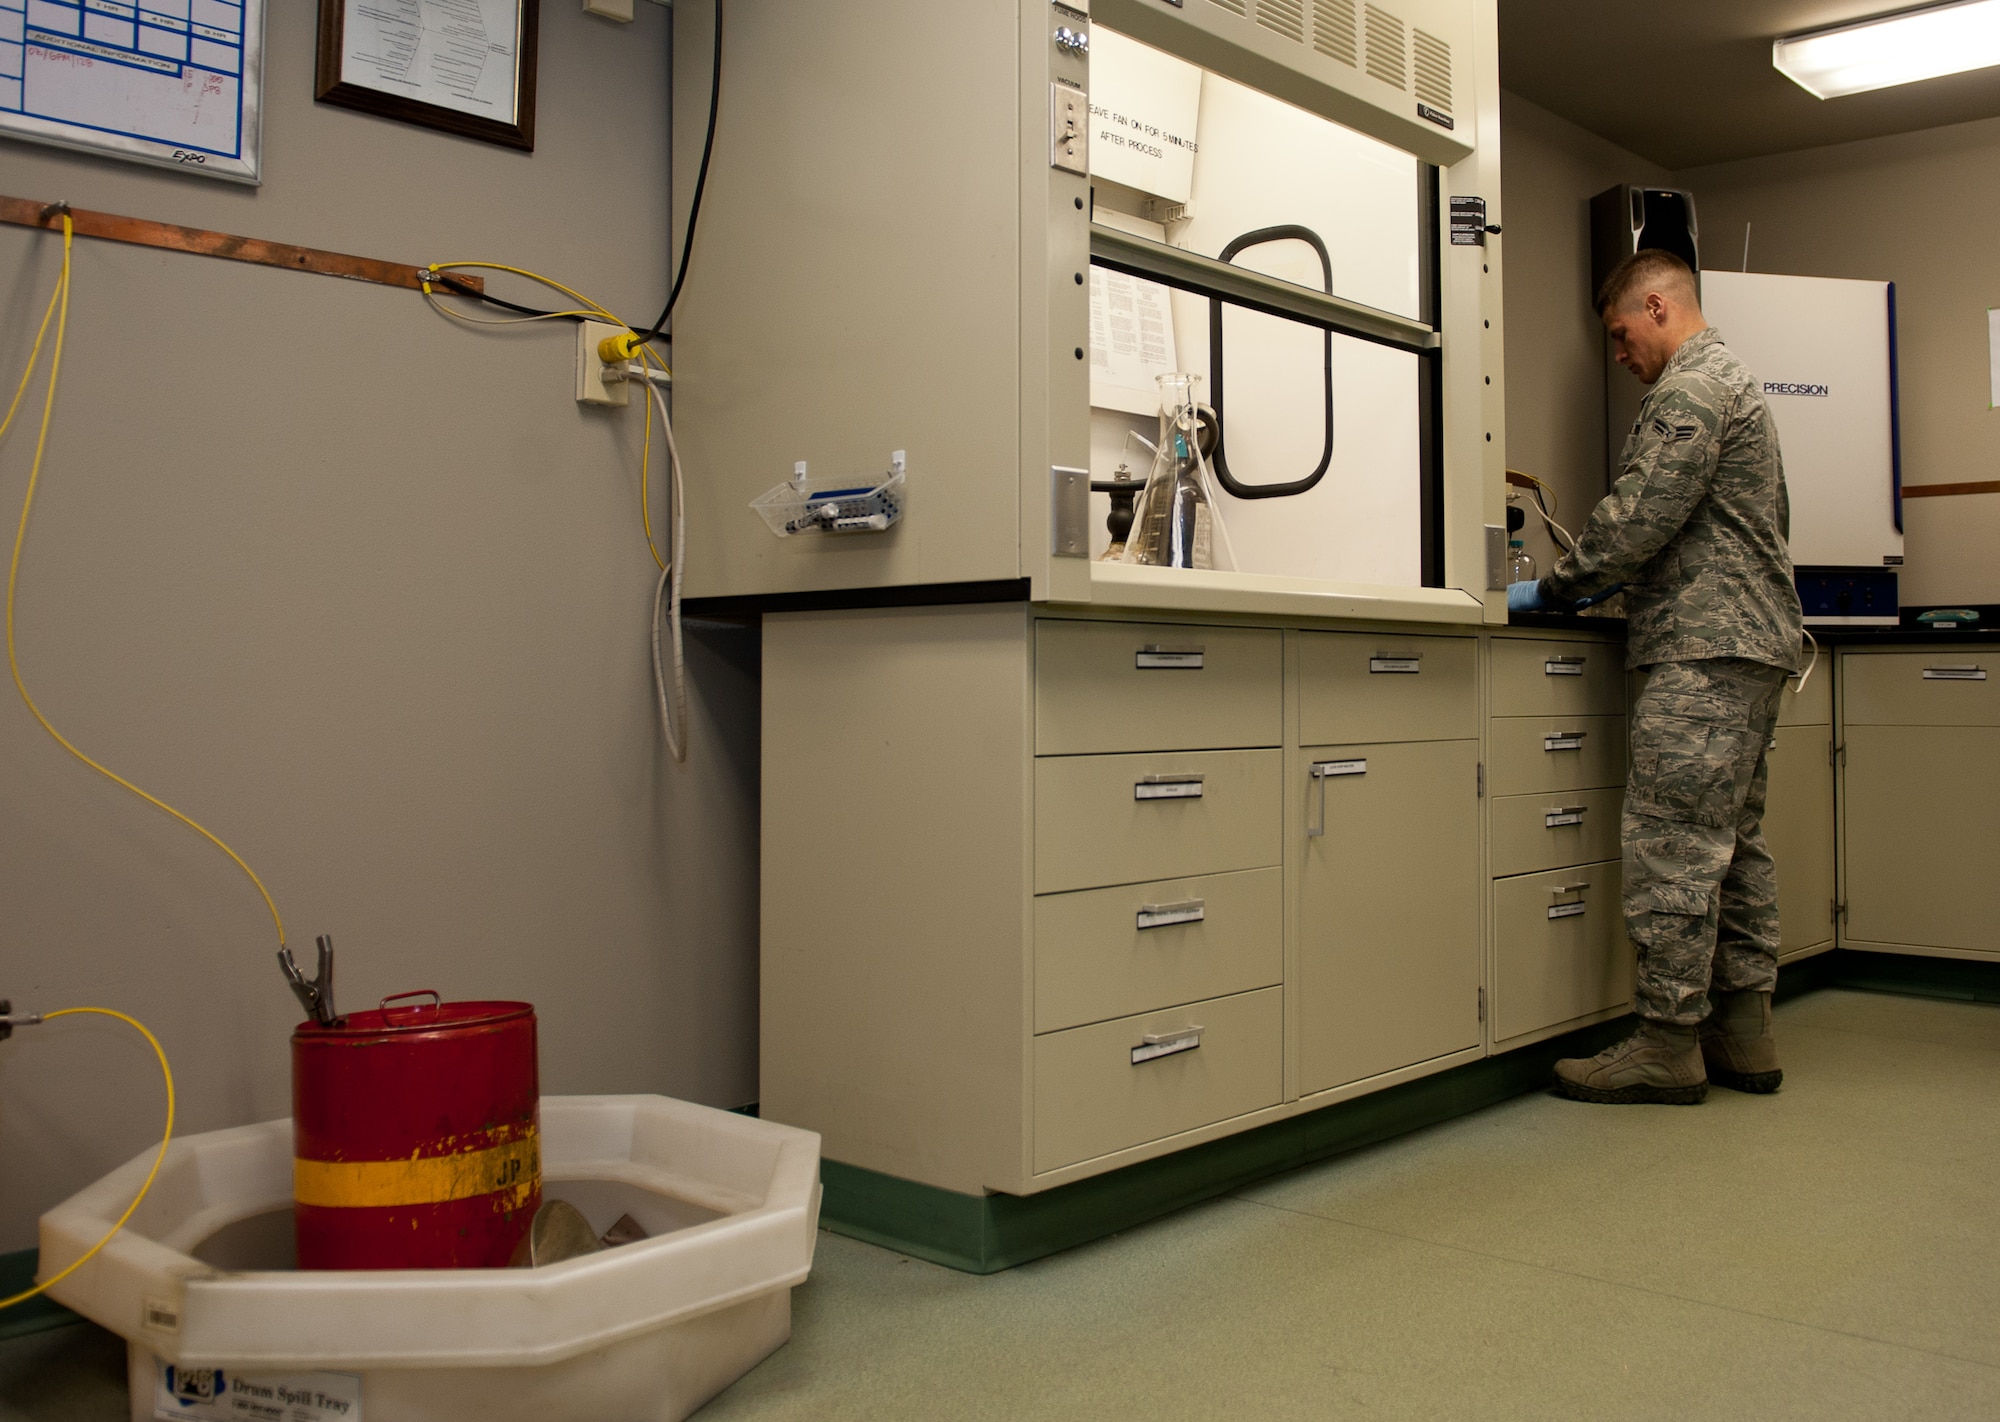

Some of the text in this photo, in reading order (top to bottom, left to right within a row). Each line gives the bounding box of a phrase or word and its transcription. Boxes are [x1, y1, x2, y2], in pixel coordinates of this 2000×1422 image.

[103, 4, 119, 12] HR
[159, 18, 175, 26] HR
[34, 33, 171, 69] ADDITIONAL INFORMATION
[1057, 76, 1081, 89] VACUUM
[1089, 104, 1199, 153] EAVE FAN ON FOR 5 MINUTES
[1100, 131, 1163, 159] AFTER PROCESS
[172, 150, 206, 164] EXPO
[1763, 382, 1828, 395] PRECISION
[496, 1159, 521, 1186] JP
[232, 1378, 273, 1399] Drum
[277, 1386, 311, 1405] Spill
[314, 1392, 350, 1416] Tray
